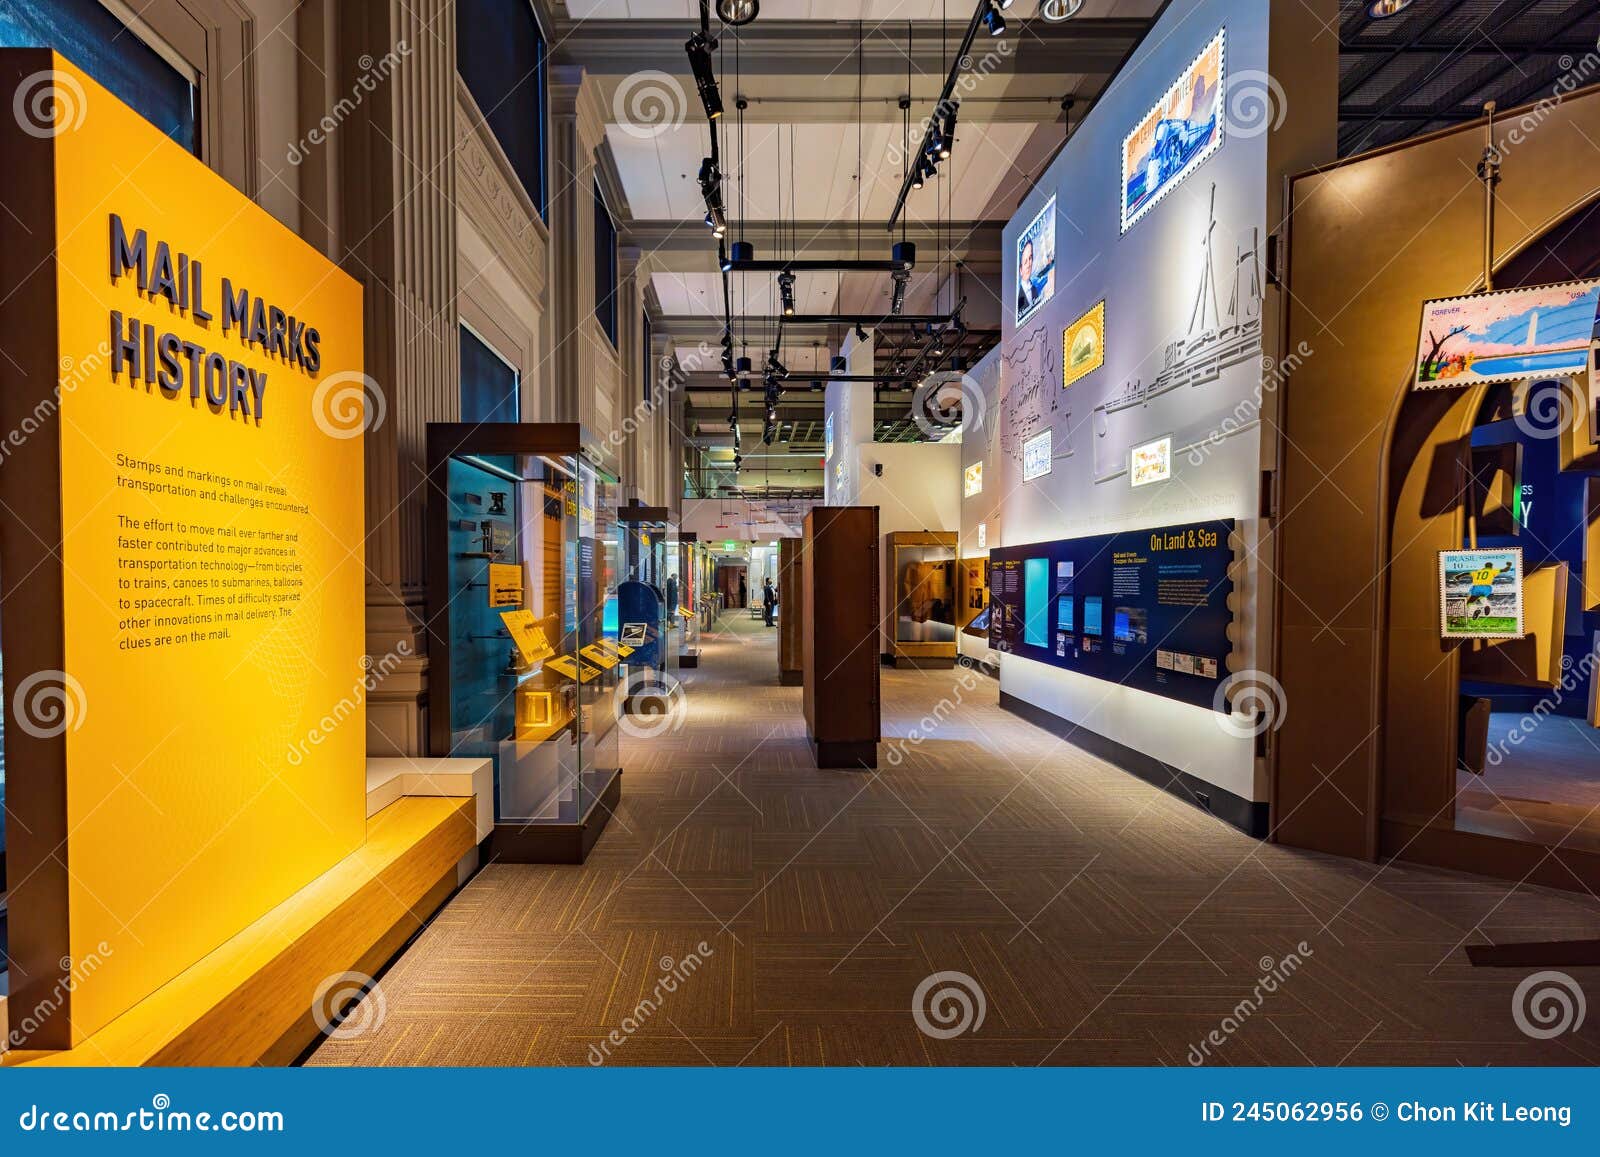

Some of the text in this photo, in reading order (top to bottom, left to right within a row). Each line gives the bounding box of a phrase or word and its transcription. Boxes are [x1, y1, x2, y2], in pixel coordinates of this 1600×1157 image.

[109, 213, 321, 373] MAIL MARKS
[1431, 306, 1461, 317] FOREVER
[110, 310, 268, 420] HISTORY
[117, 454, 287, 496] Stamps and markings on mail reveal
[118, 475, 308, 514] transportation and challenges encountered
[118, 515, 298, 542] The effort to move mail ever farther and
[118, 536, 295, 556] faster contributed to major advances in
[1150, 529, 1217, 551] On Land & Sea
[119, 558, 197, 571] transportation
[276, 562, 302, 572] bicycles
[1447, 555, 1476, 563] BRASIL
[119, 577, 302, 589] to trains, canoes to submarines, balloons
[1476, 571, 1489, 580] 10
[119, 593, 300, 610] to spacecraft. Times of difficulty sparked
[120, 617, 150, 629] other
[155, 613, 212, 627] innovations
[215, 612, 222, 621] in
[226, 609, 243, 620] mail
[279, 607, 292, 616] The
[120, 628, 230, 650] clues are on the mail.
